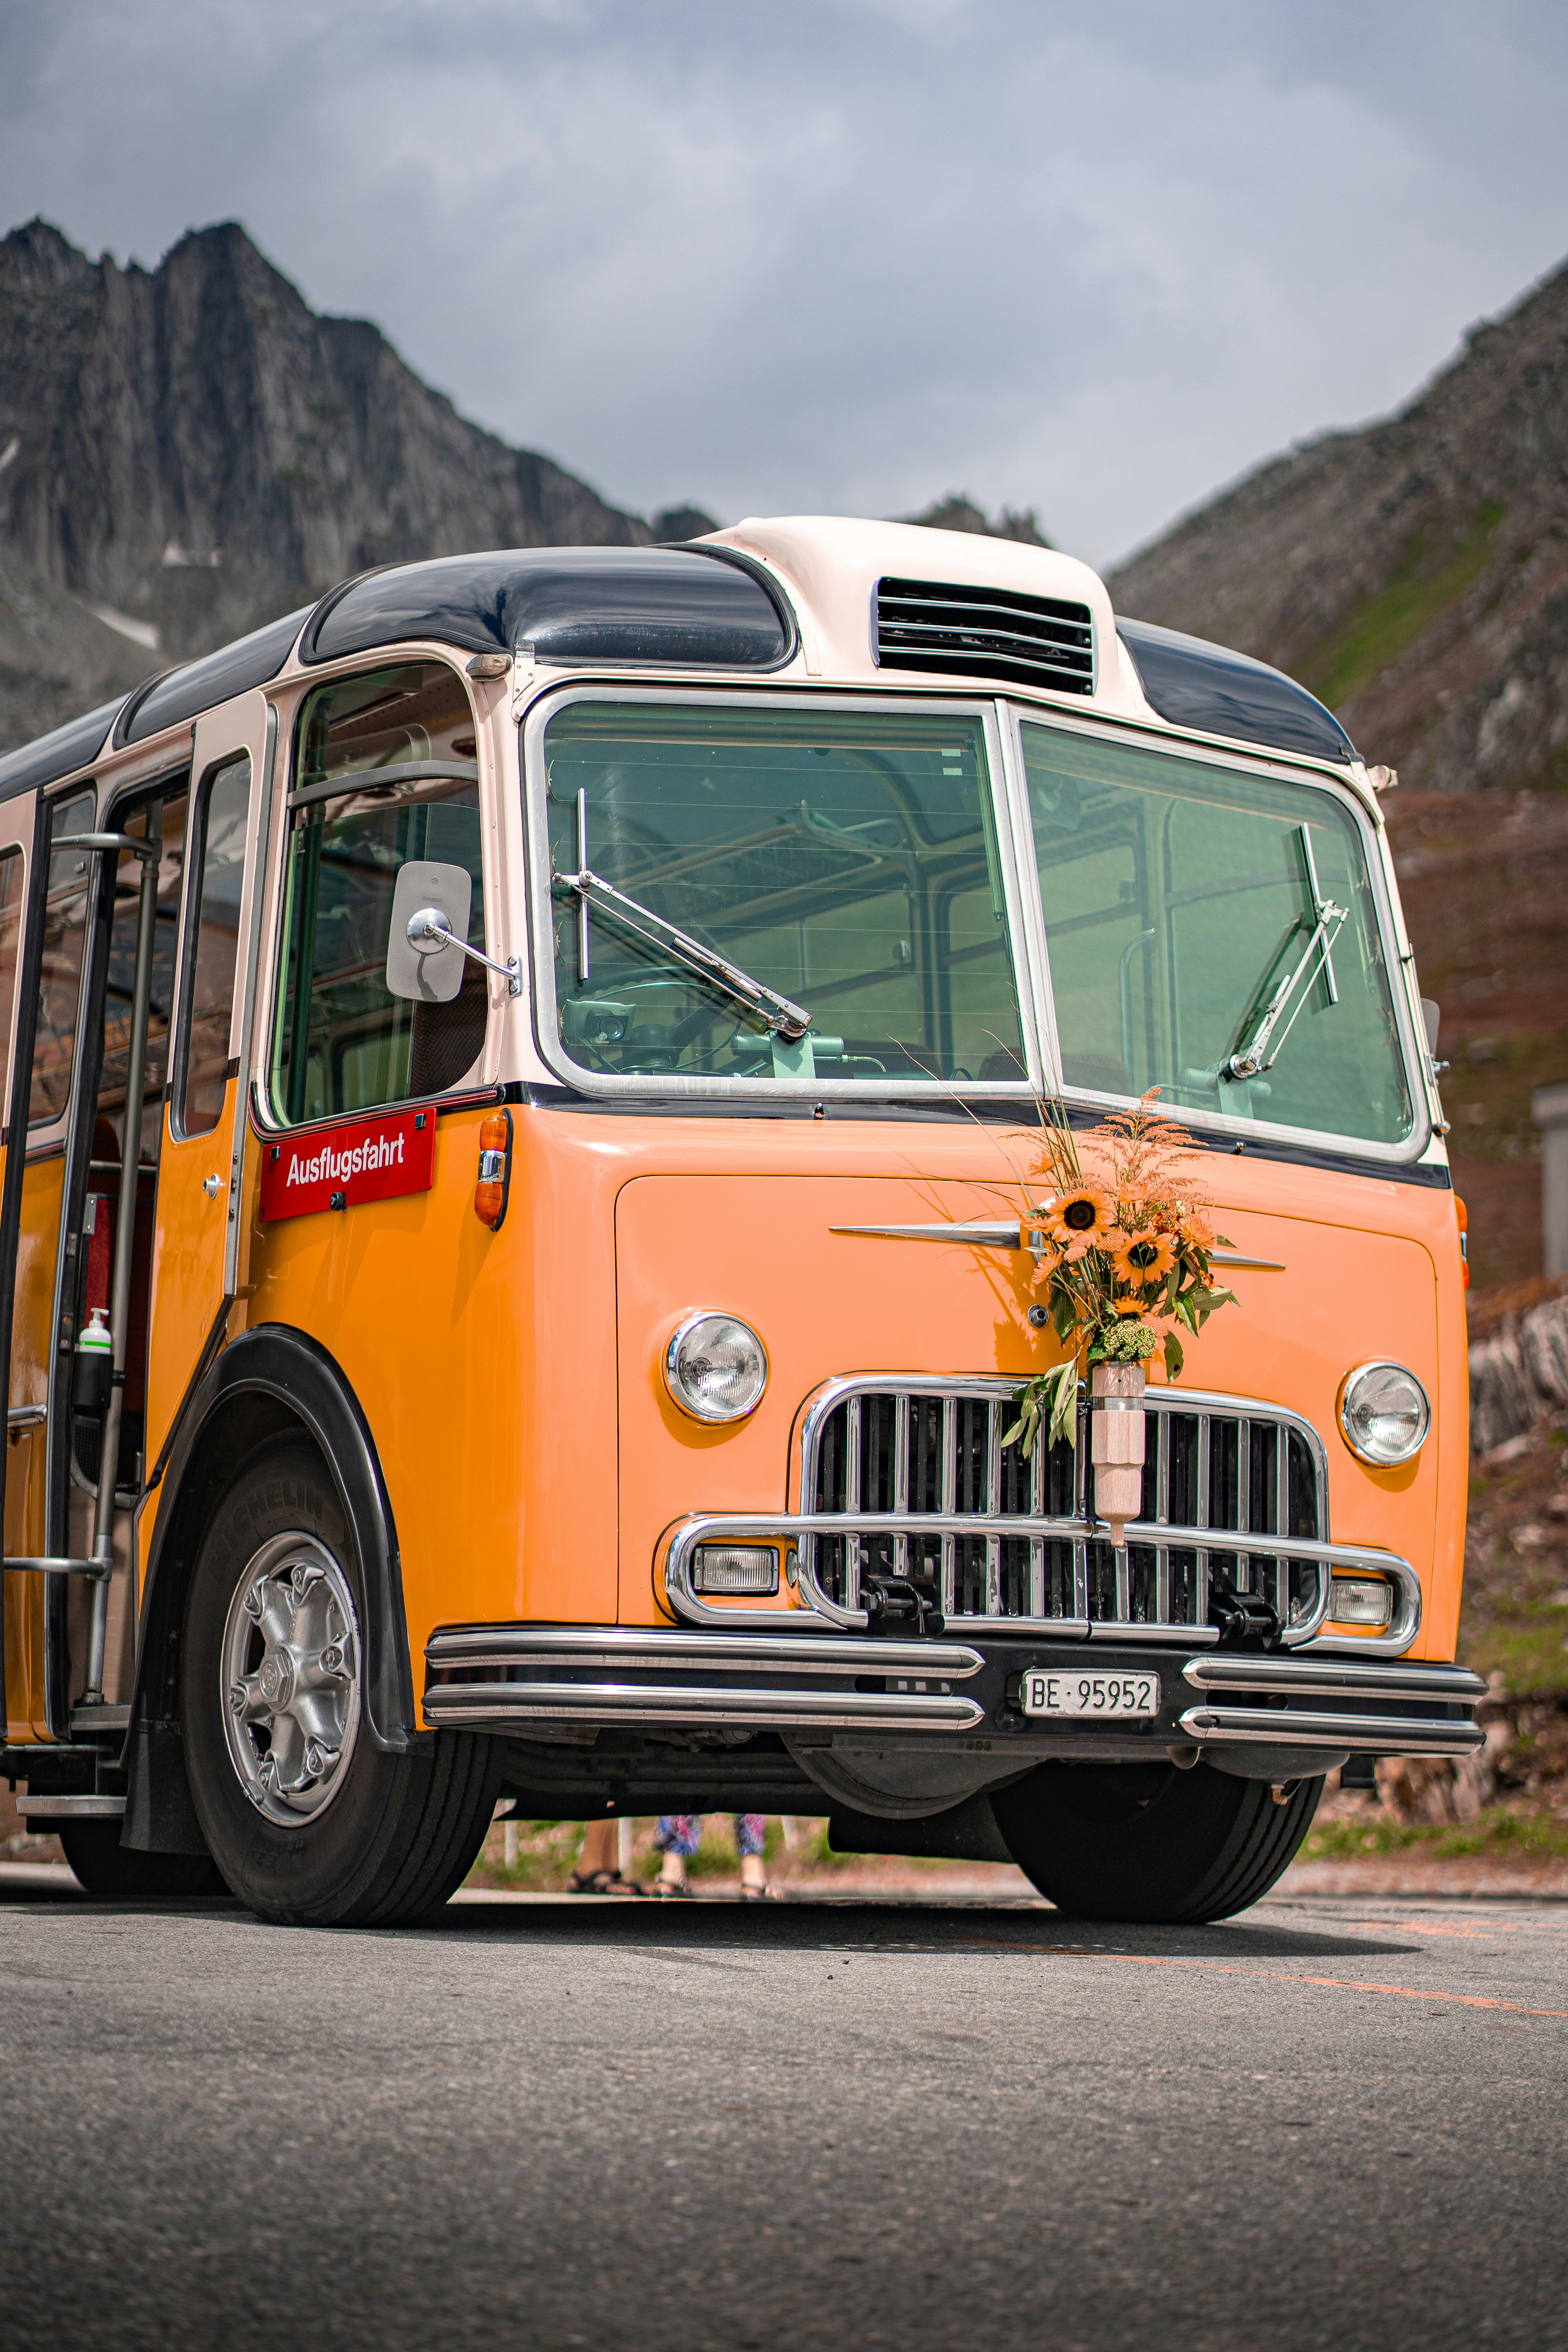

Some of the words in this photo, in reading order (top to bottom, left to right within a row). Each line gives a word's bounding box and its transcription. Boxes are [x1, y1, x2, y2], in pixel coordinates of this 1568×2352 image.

[286, 1132, 404, 1187] Ausflugsfahrt
[261, 1206, 265, 1220] 1
[1032, 1678, 1060, 1708] BE
[1078, 1679, 1151, 1710] 95952
